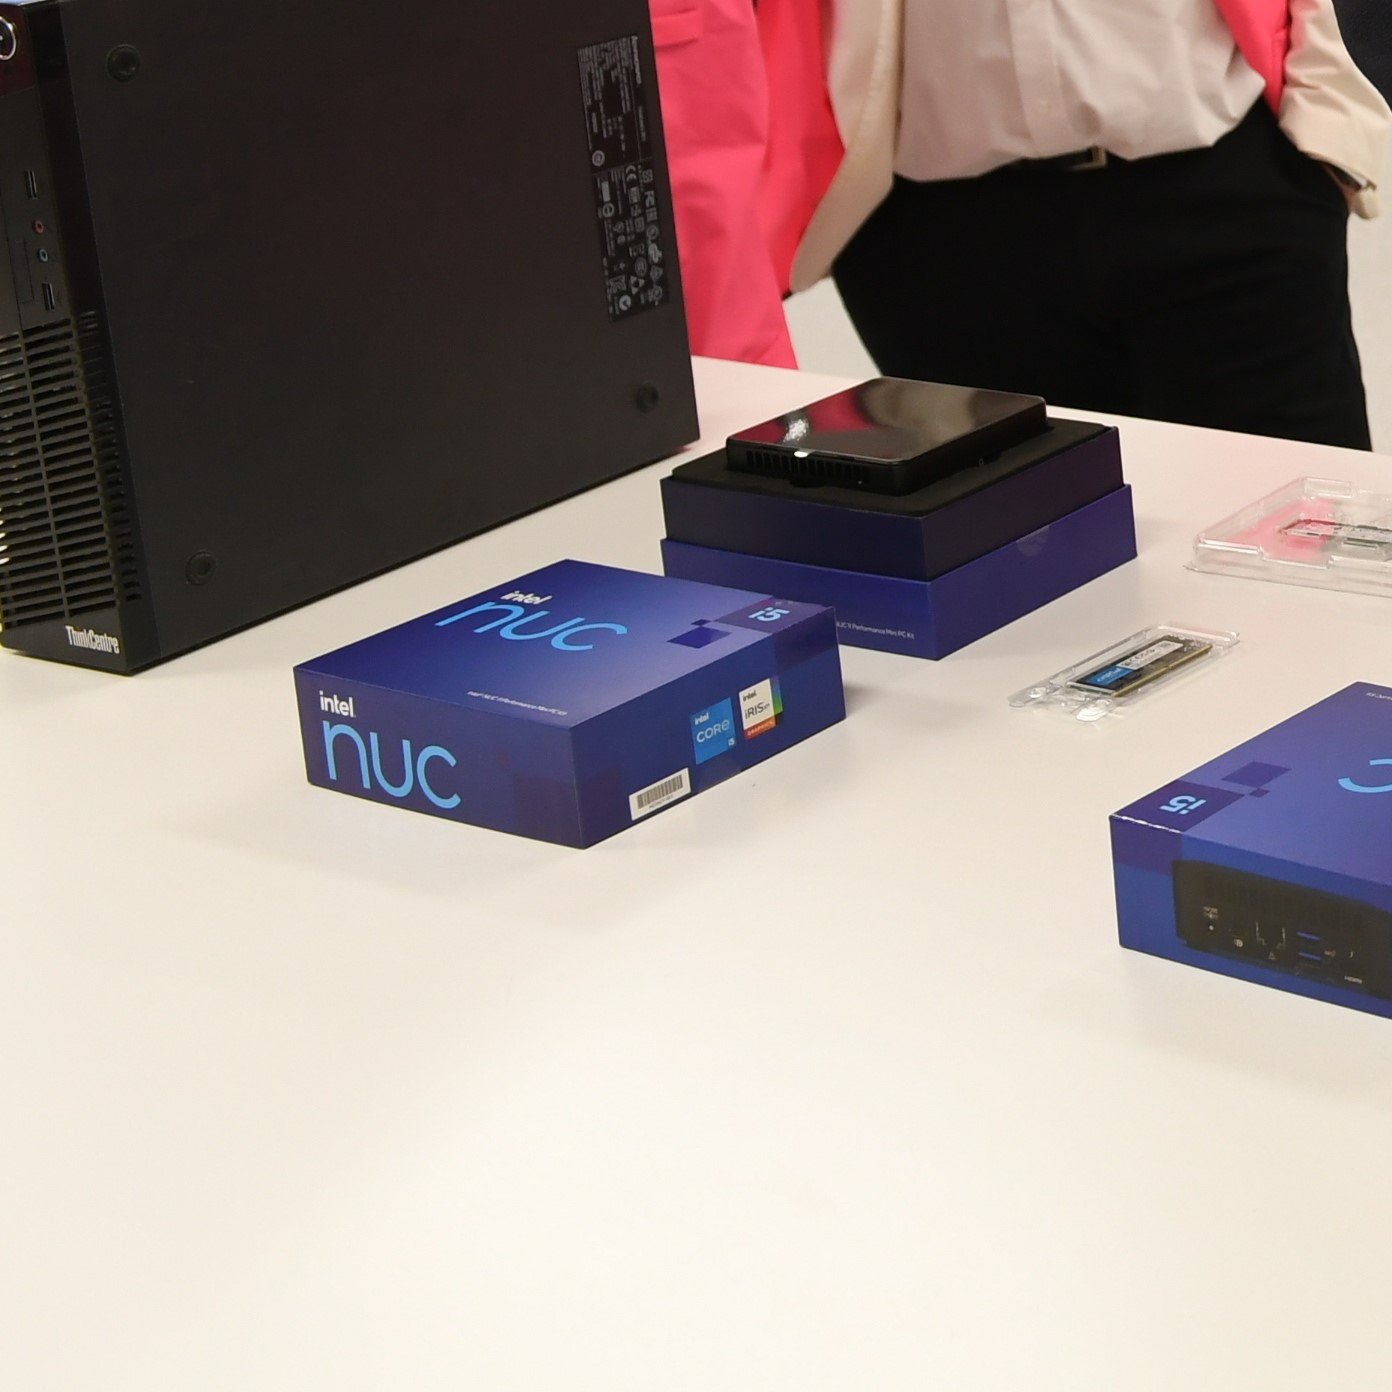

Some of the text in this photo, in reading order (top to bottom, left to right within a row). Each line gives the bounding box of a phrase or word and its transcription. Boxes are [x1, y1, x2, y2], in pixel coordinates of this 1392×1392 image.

[500, 591, 552, 605] intel
[748, 606, 790, 622] i5
[434, 601, 628, 651] nuc
[65, 624, 120, 655] ThinkCentre
[319, 690, 355, 718] intel
[743, 689, 757, 702] intel
[694, 711, 709, 726] intel
[323, 720, 462, 809] nuc
[1160, 795, 1207, 815] i5
